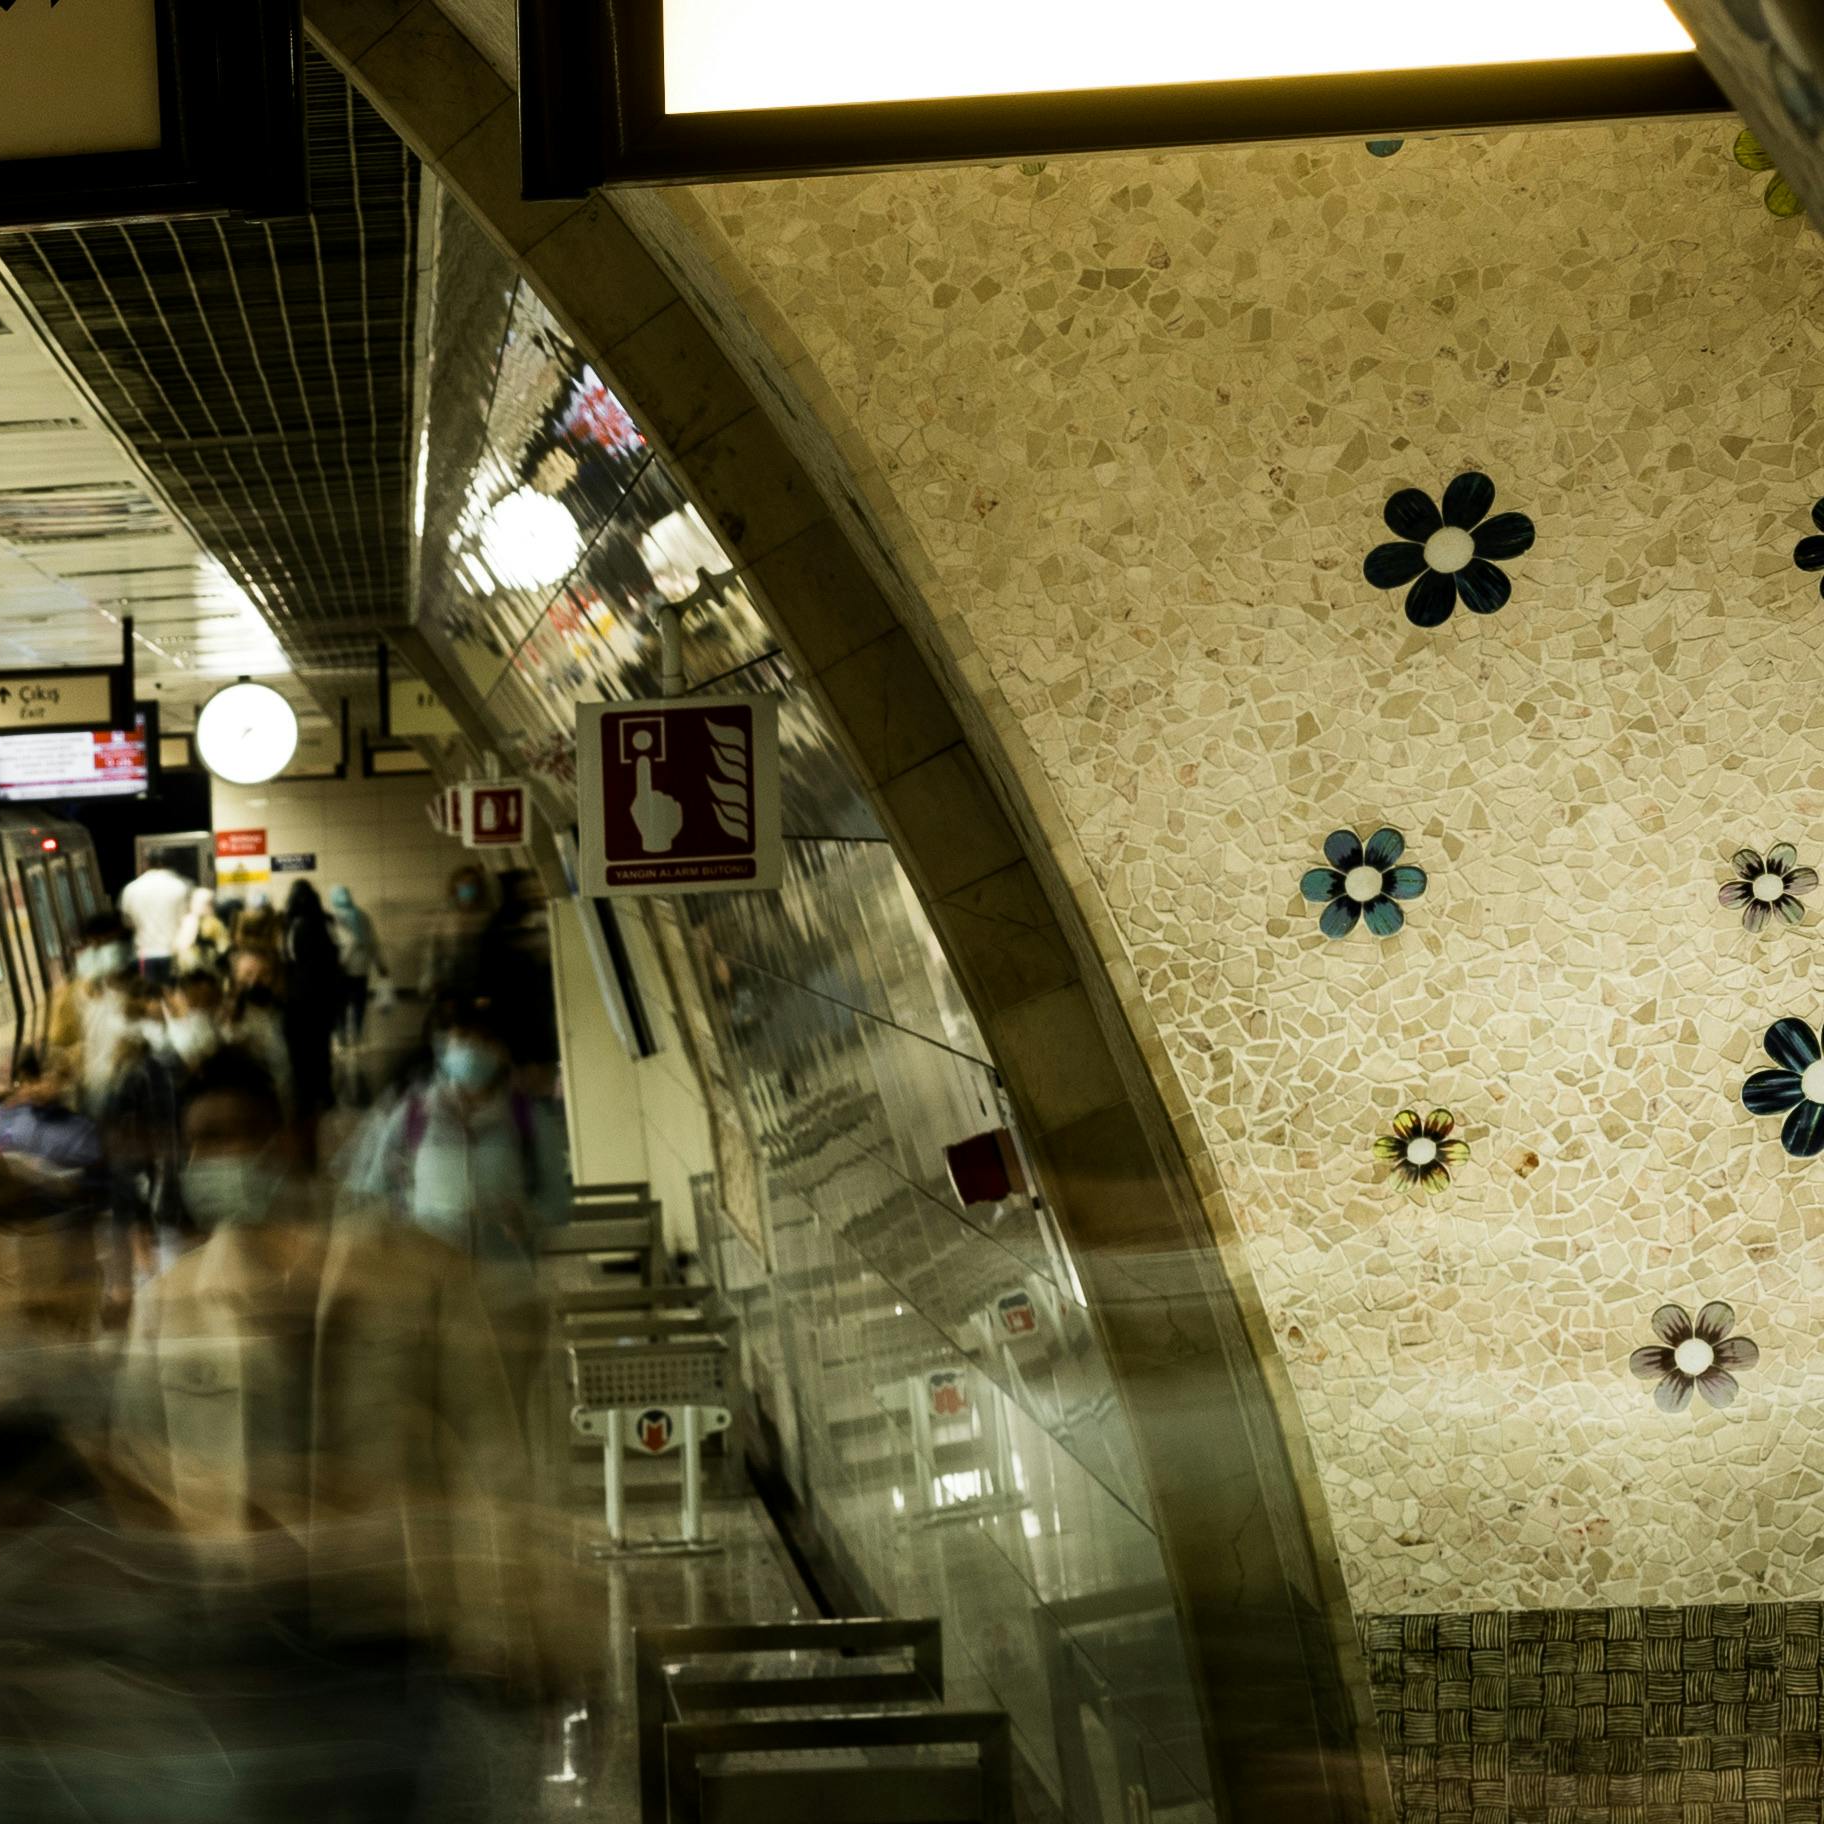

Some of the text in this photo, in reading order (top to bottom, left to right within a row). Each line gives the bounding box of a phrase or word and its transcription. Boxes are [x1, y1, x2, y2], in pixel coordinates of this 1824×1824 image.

[19, 684, 59, 704] Çıkış
[20, 707, 46, 719] Exit
[615, 864, 748, 881] YANGIN ALARM BUTONU
